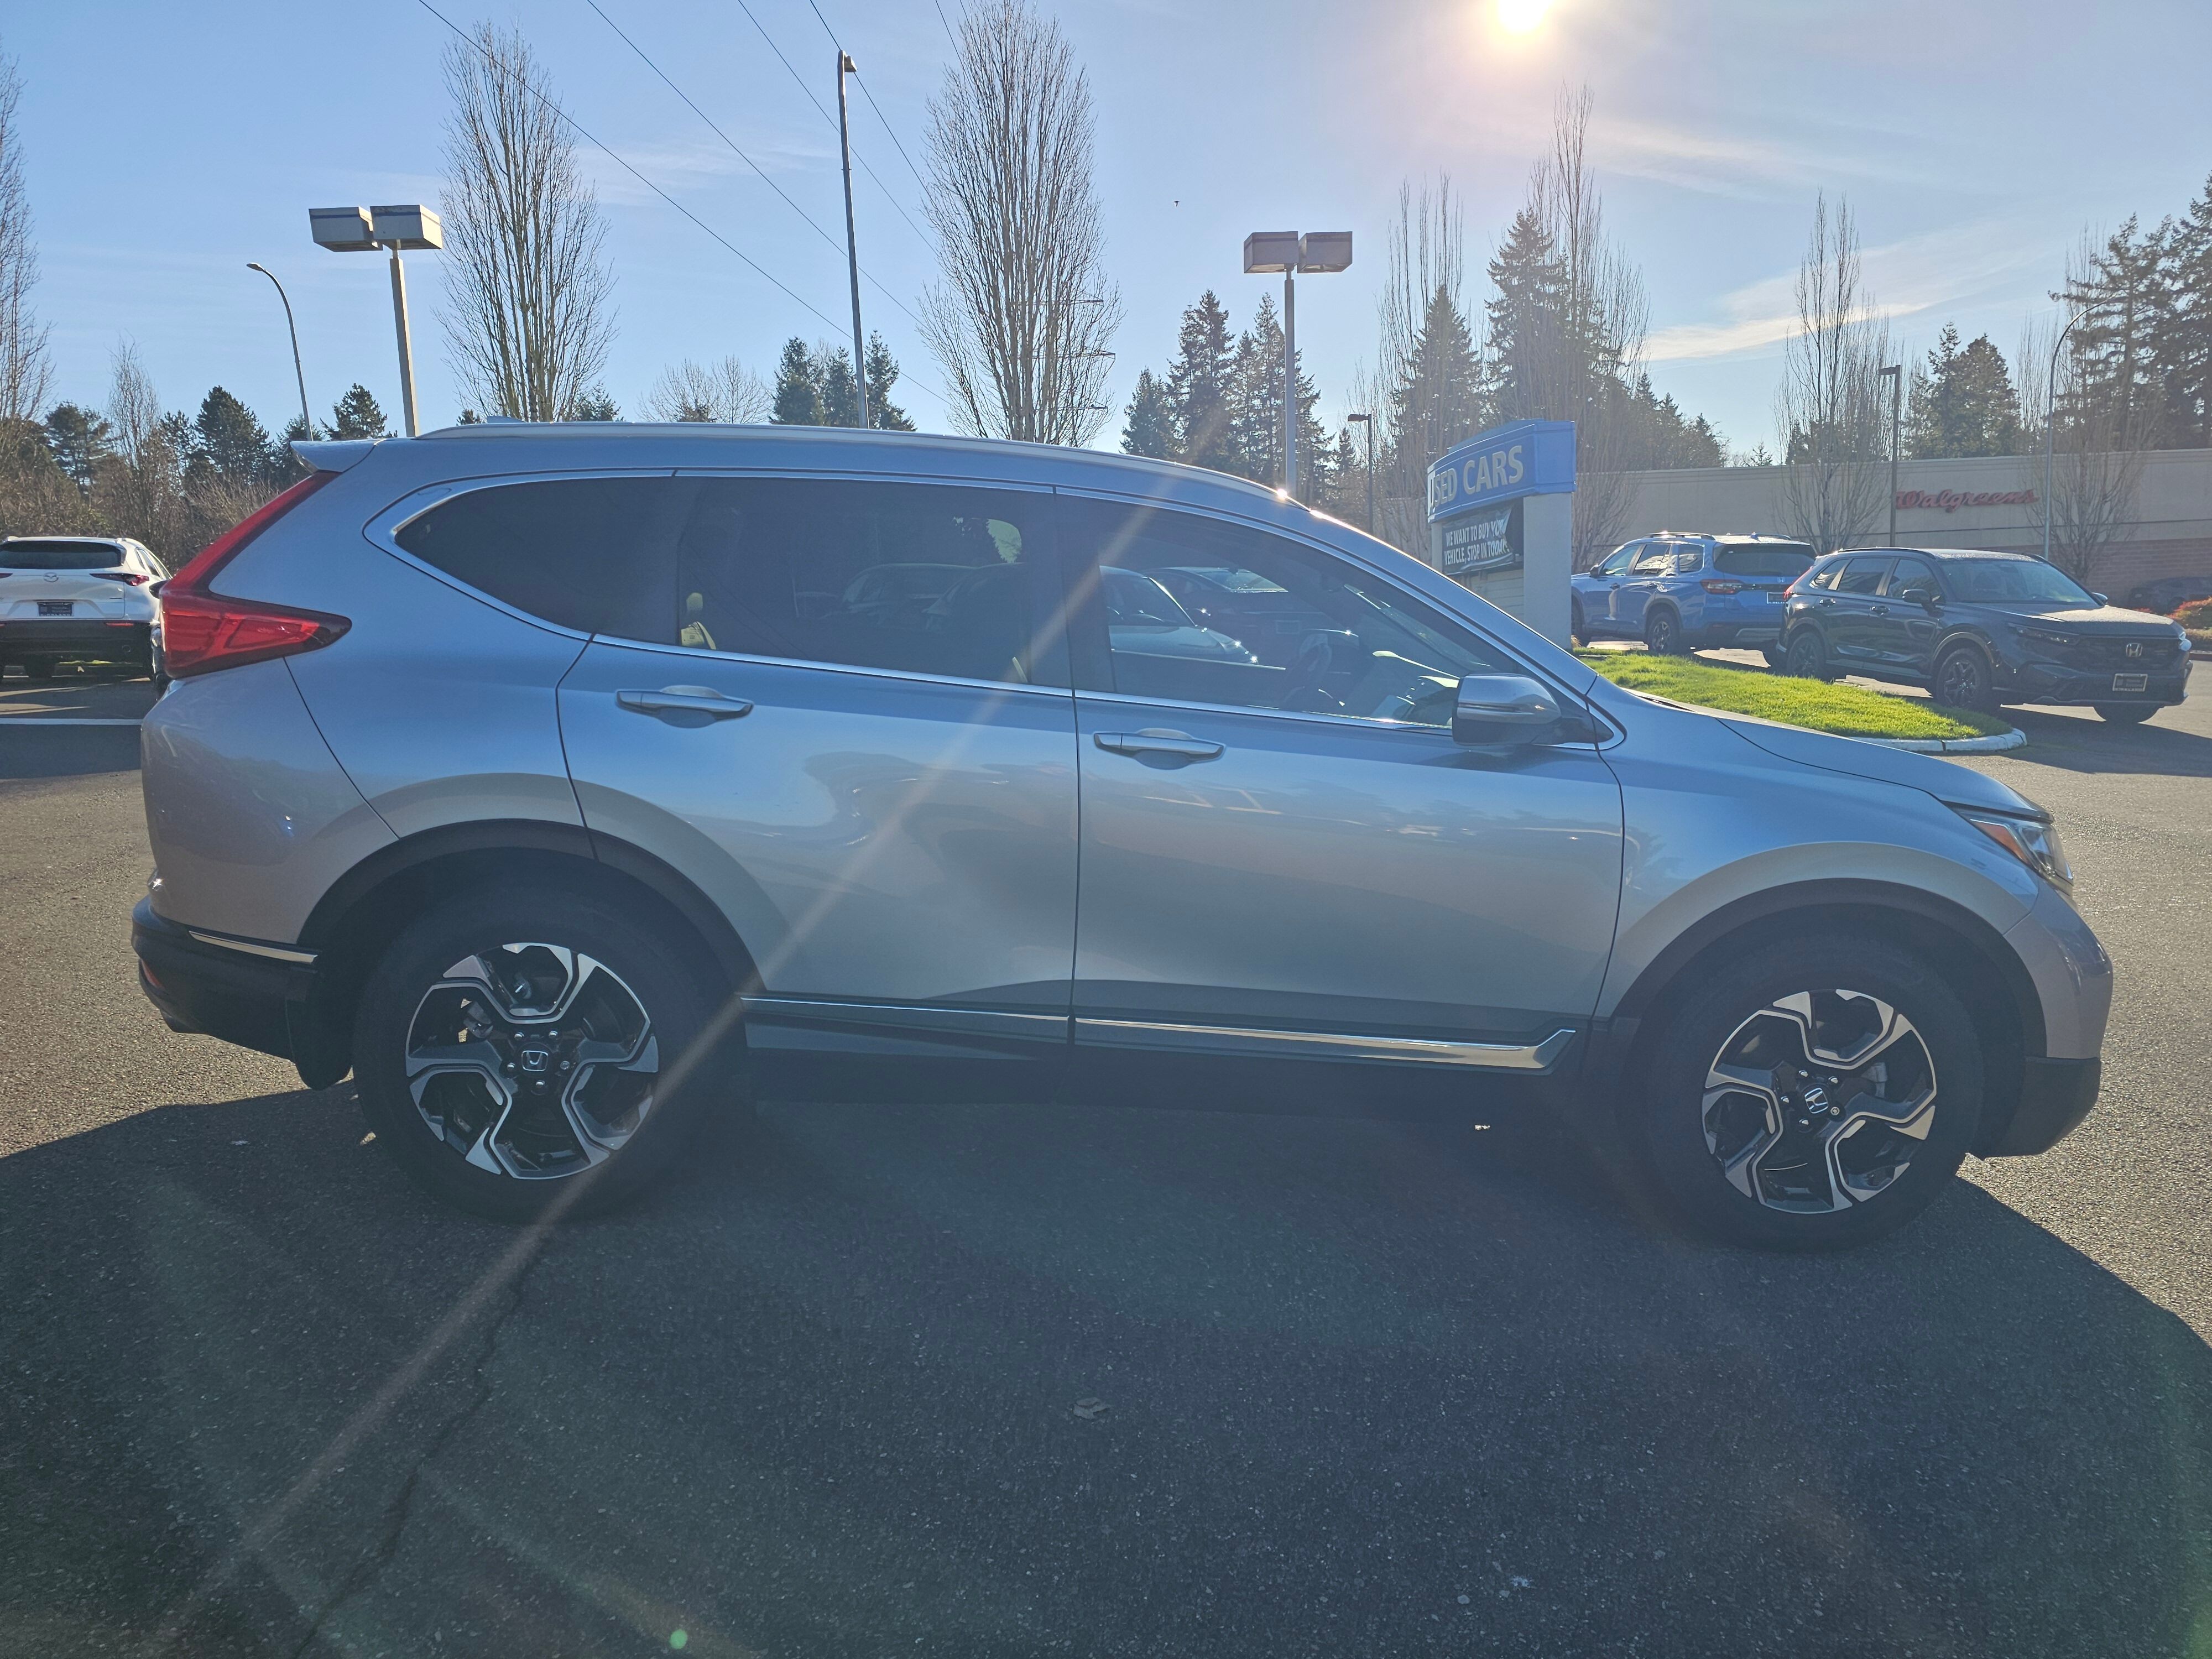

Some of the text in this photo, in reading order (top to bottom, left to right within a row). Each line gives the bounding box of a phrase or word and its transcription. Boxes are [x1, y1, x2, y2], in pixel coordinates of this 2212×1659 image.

[1463, 445, 1524, 495] CARS
[1896, 488, 2040, 514] Walgreens
[1446, 531, 1453, 547] WE
[1453, 527, 1470, 545] WANT
[1470, 525, 1478, 541] TO
[1478, 522, 1490, 540] BUY
[1444, 547, 1467, 566] VEHICLE,
[1467, 544, 1480, 561] STOP
[1481, 542, 1488, 559] IN
